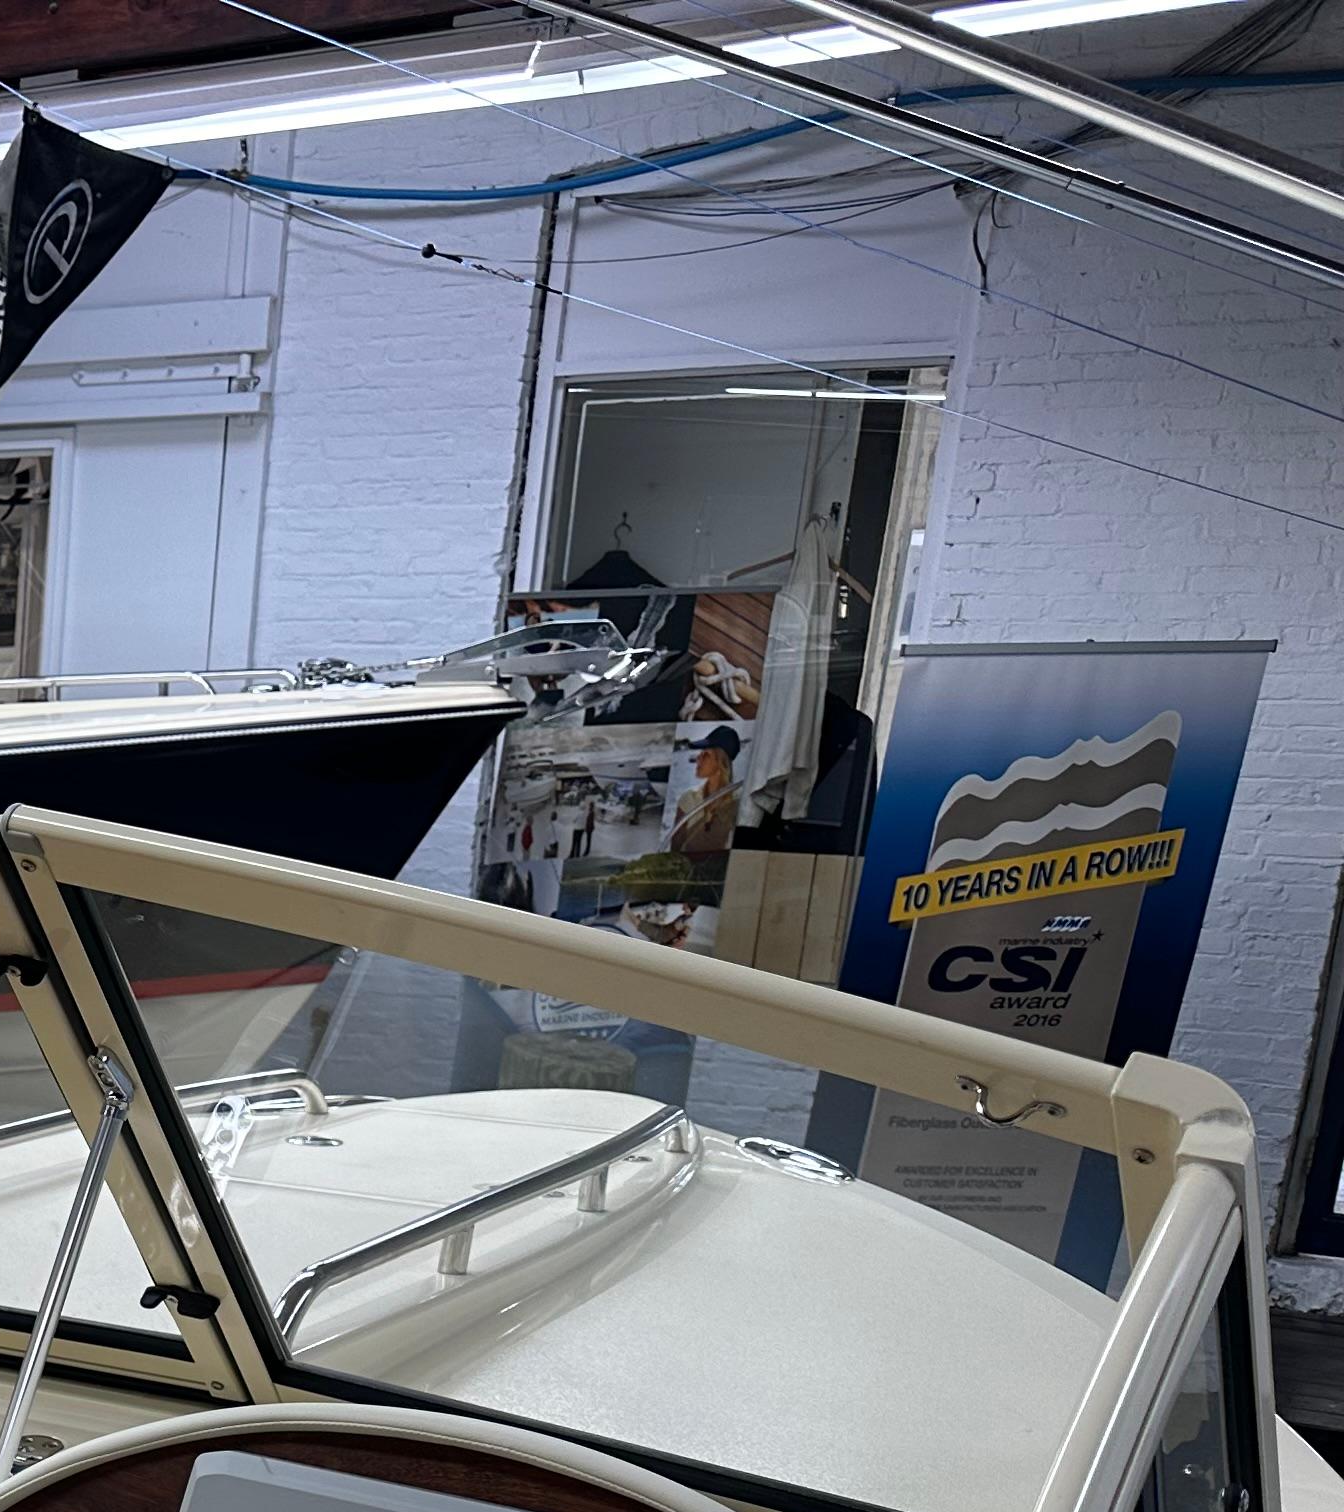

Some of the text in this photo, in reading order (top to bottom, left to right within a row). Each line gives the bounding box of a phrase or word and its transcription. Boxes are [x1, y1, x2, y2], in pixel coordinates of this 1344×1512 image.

[902, 838, 1175, 912] 10 YEARS IN A ROW!!!
[999, 936, 1089, 947] marine industry
[927, 946, 1088, 993] CSI
[989, 993, 1072, 1009] award
[1013, 1014, 1062, 1027] 2016
[888, 1115, 957, 1131] Fiberglass
